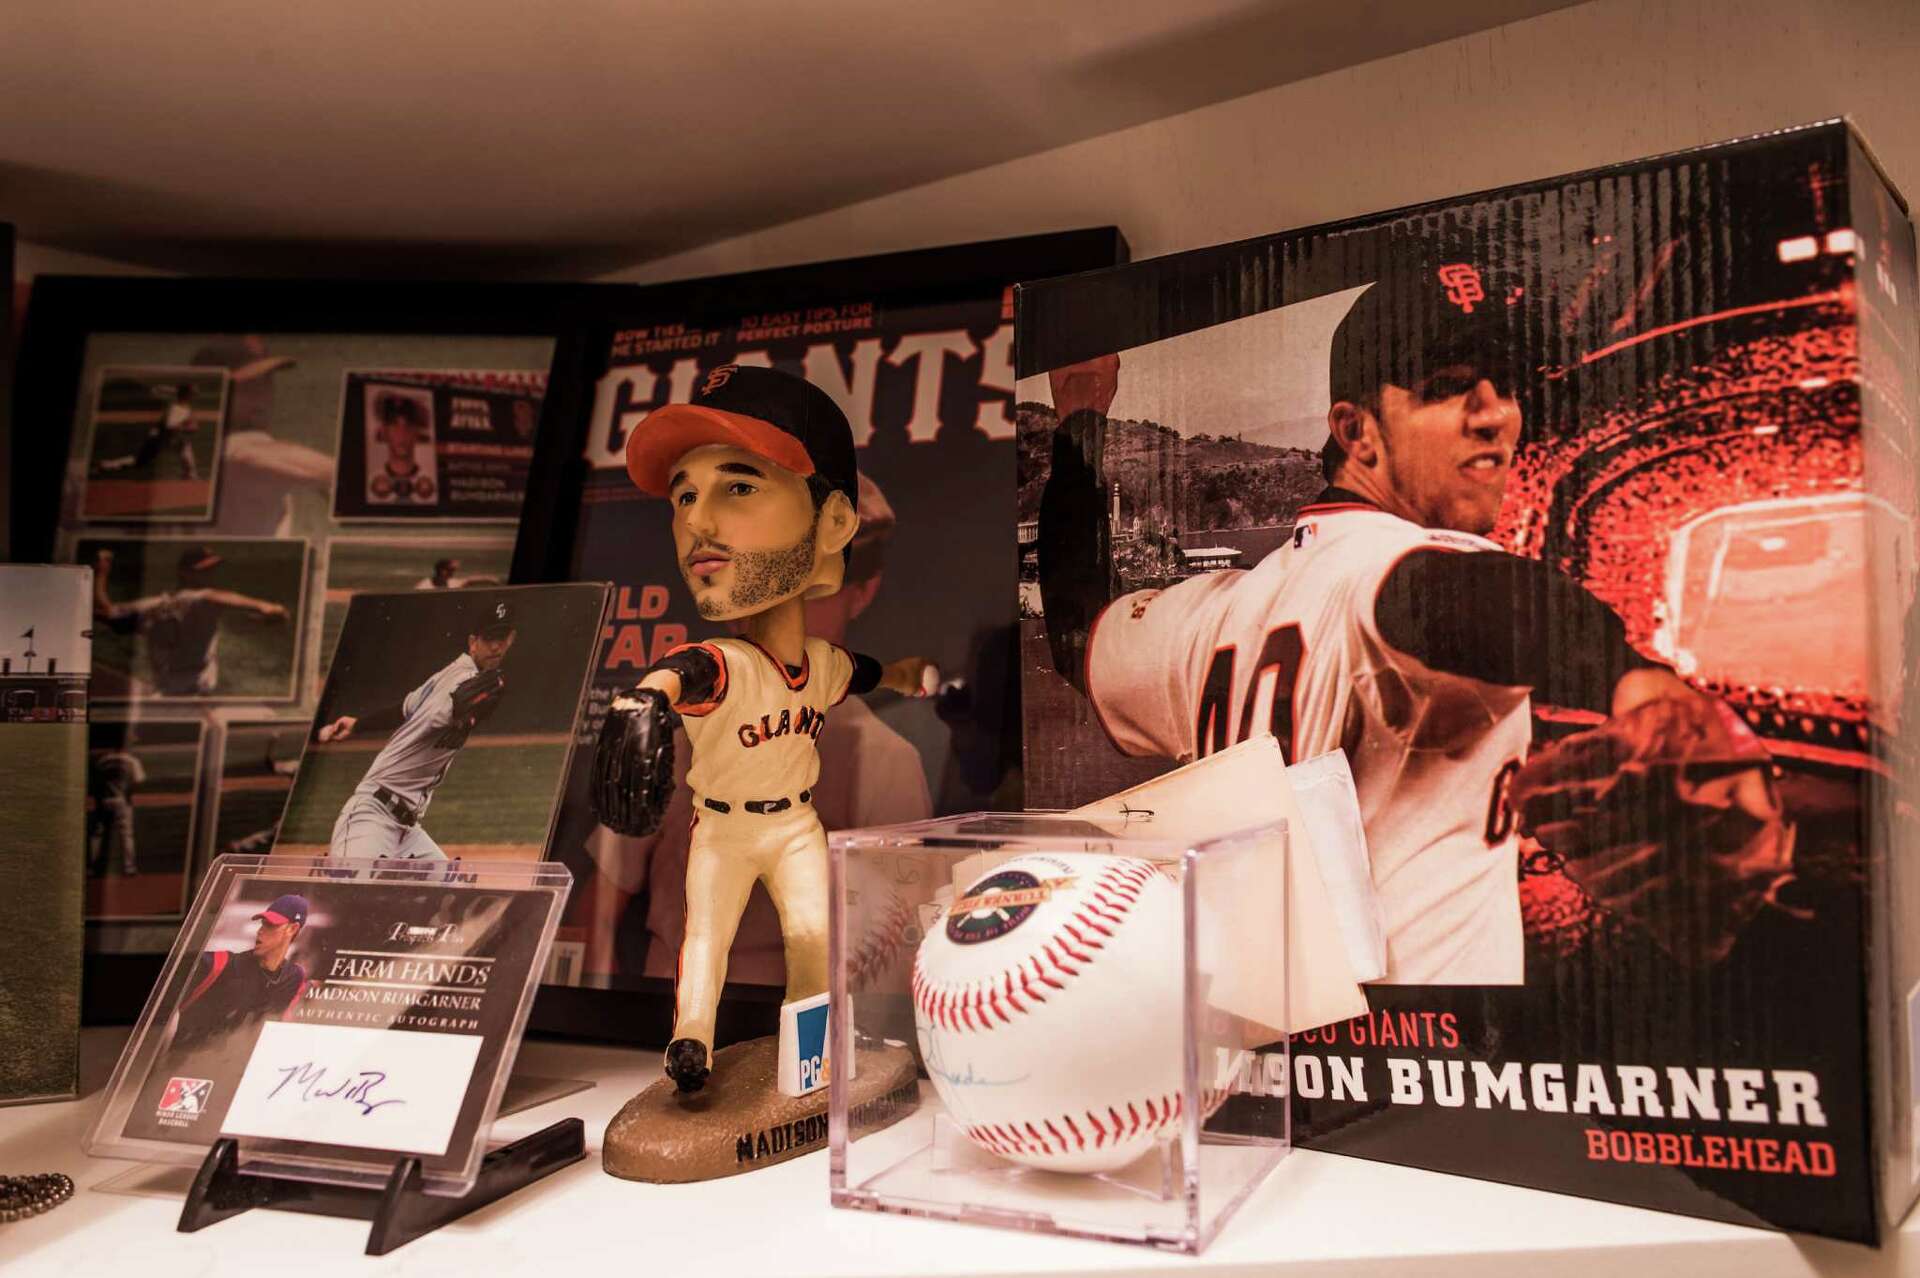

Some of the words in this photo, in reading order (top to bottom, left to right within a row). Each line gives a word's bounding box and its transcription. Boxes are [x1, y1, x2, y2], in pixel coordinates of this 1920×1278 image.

[634, 334, 702, 354] STARTED
[736, 323, 801, 342] PERFECT
[803, 316, 873, 335] POSTURE
[583, 325, 1015, 470] GINTS
[616, 585, 670, 620] LD
[329, 957, 394, 981] FARM
[399, 961, 491, 986] HANDS
[305, 985, 379, 1006] MADISON
[382, 989, 482, 1011] BUMGARNER
[296, 1007, 381, 1025] AUTHENTIC
[389, 1012, 480, 1030] AUTOGRAPH
[1349, 1007, 1461, 1049] GIANTS
[800, 1055, 831, 1091] PG&
[1387, 1057, 1829, 1127] BUMGARNER
[735, 1111, 830, 1163] MADISON
[1585, 1129, 1837, 1178] BOBBLEHEAD
